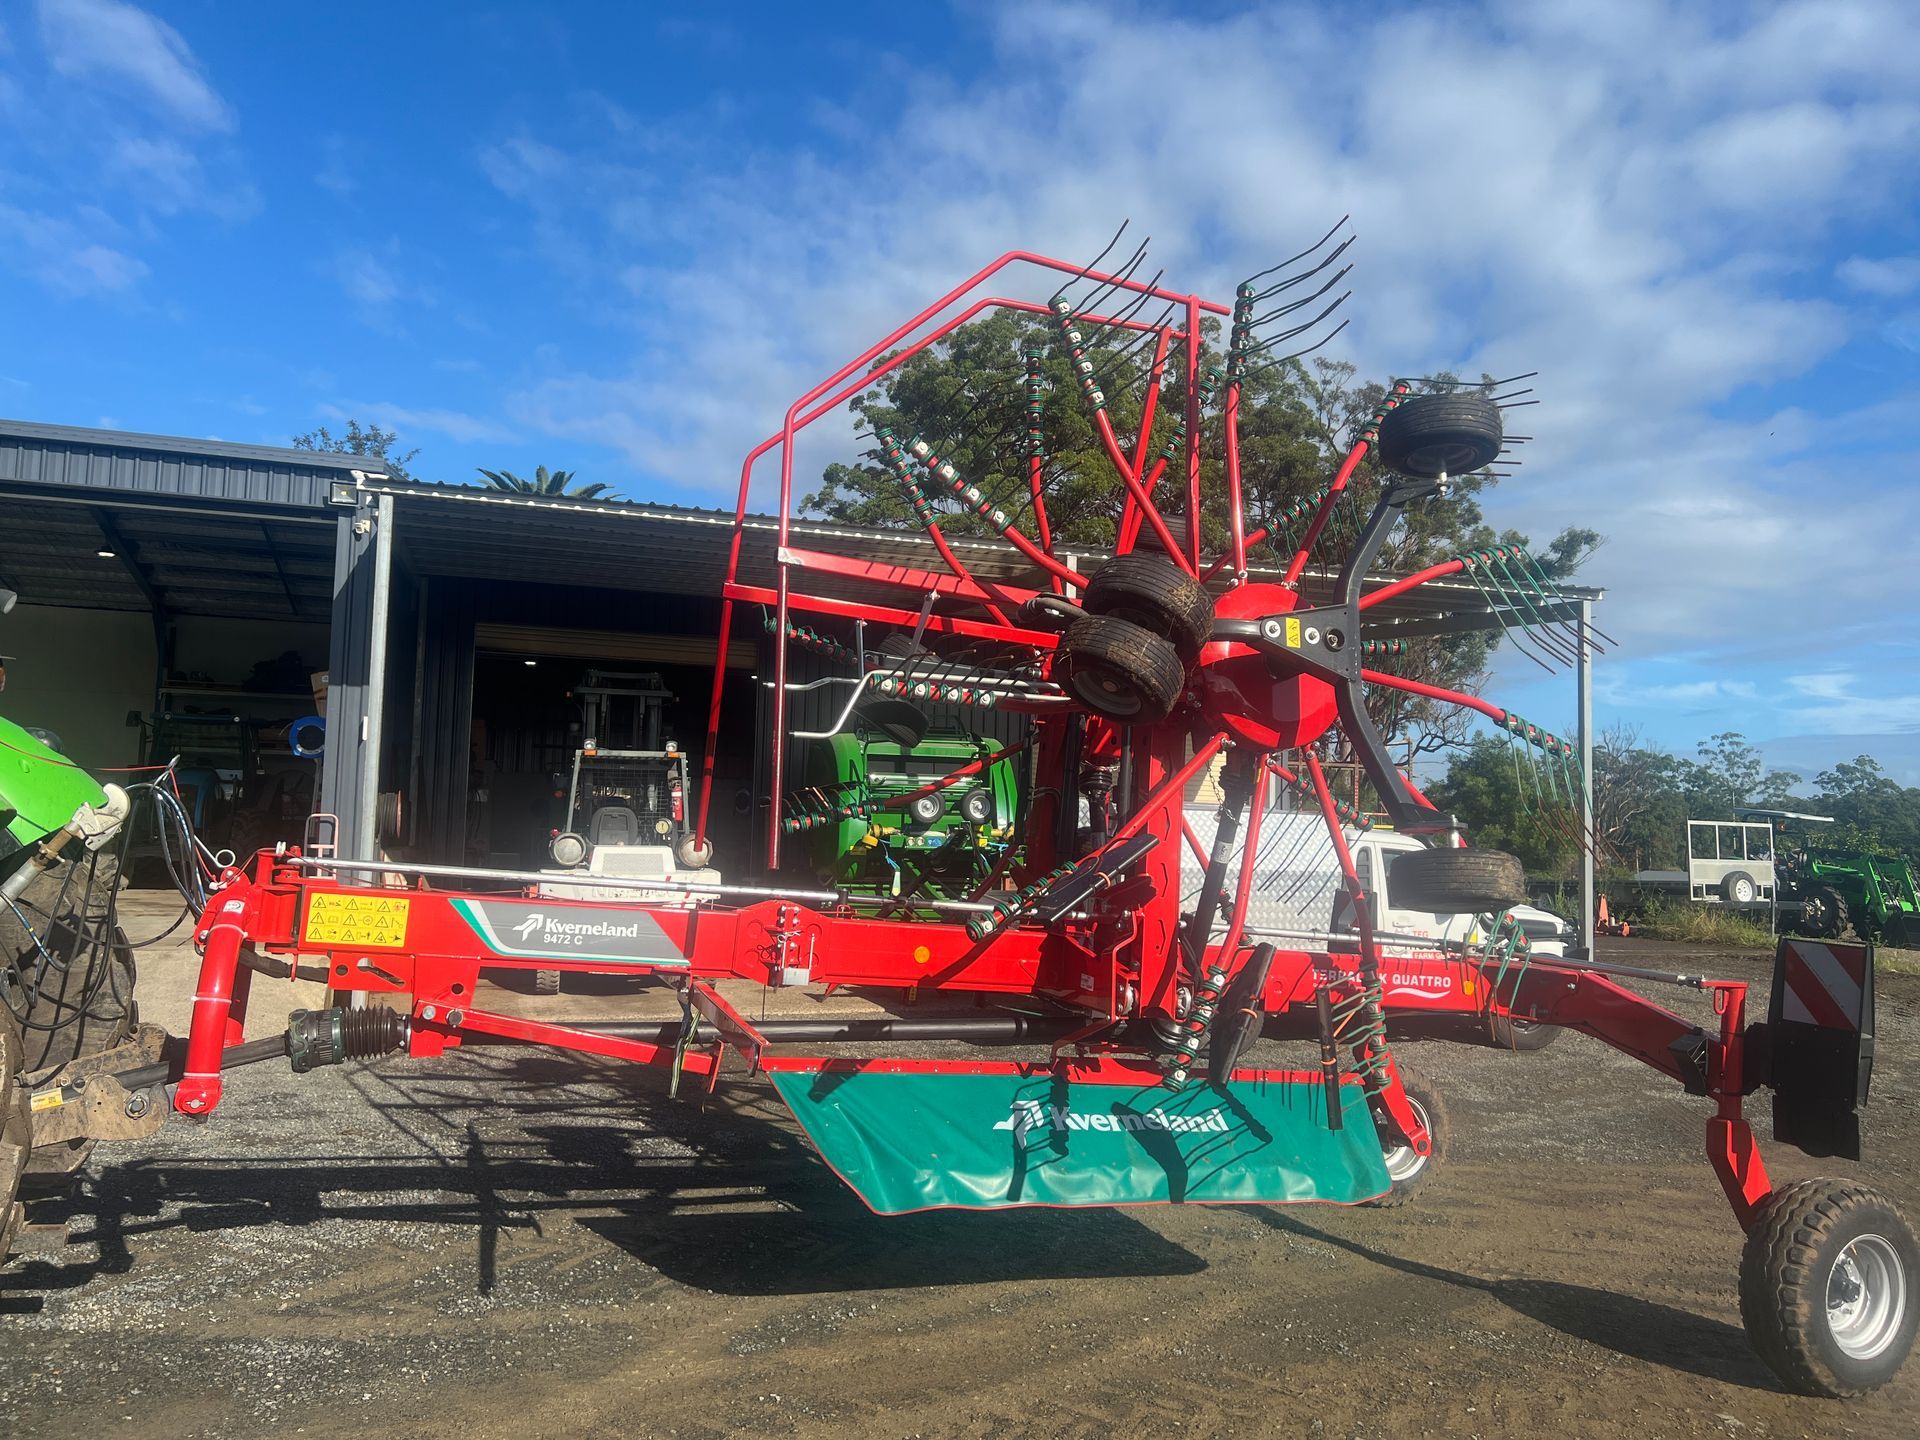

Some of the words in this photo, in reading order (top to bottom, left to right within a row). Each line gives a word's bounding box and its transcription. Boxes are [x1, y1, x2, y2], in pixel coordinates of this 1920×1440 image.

[545, 918, 638, 937] Kverneland
[543, 933, 571, 944] 9472
[574, 935, 583, 945] C
[1414, 952, 1435, 960] FARM
[1312, 968, 1387, 985] TERRALK
[1392, 973, 1451, 988] QUATTRO
[1049, 1106, 1229, 1133] Kverneland
